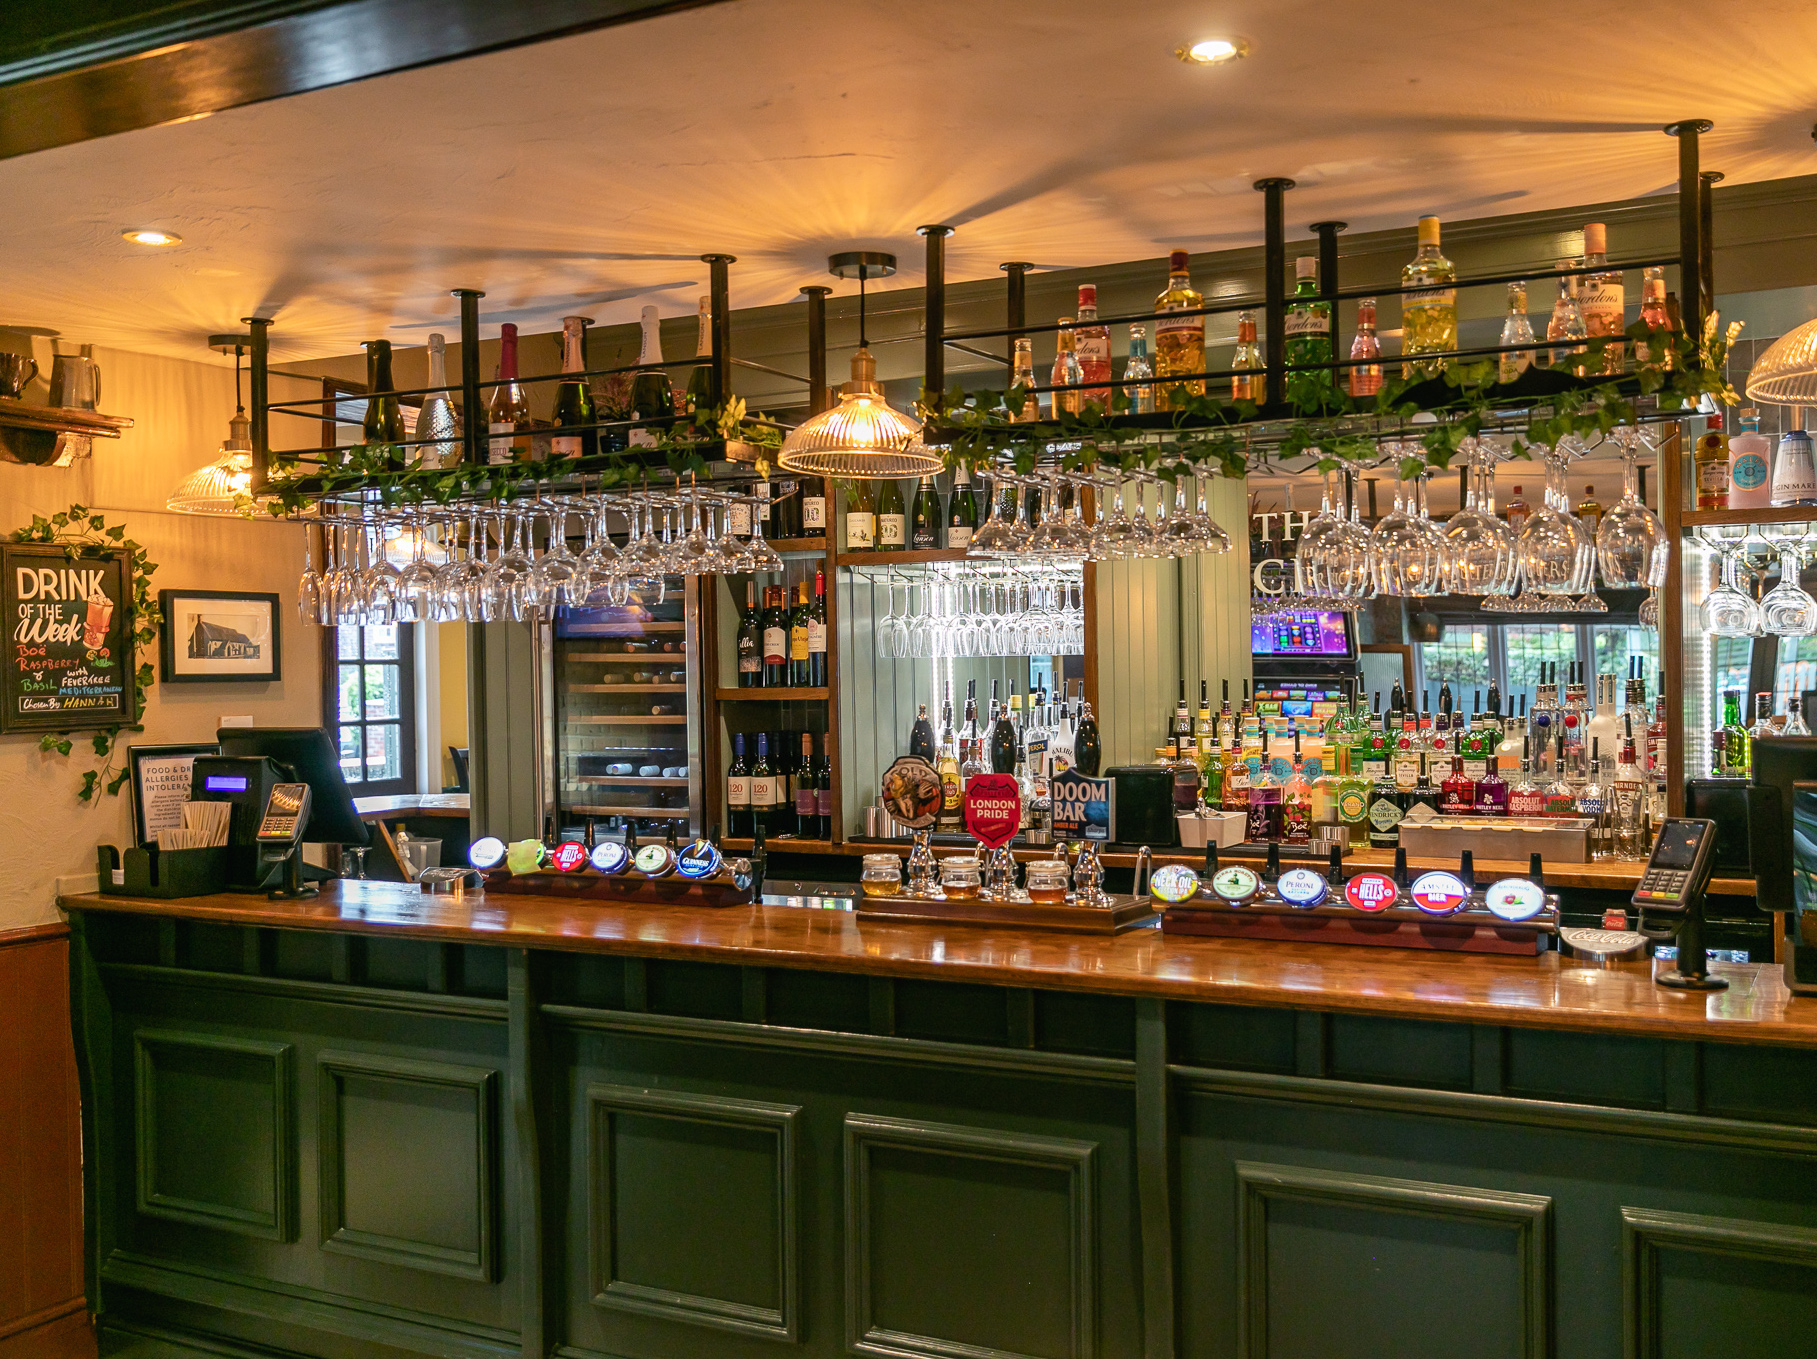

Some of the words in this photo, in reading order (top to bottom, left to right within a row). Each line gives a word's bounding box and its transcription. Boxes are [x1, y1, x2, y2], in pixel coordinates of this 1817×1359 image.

[1791, 482, 1817, 490] MARE
[1253, 510, 1336, 542] TH
[912, 532, 935, 544] Lanson
[16, 567, 106, 601] DRINK
[18, 603, 35, 619] OF
[37, 604, 63, 619] THE
[14, 613, 82, 647] Week
[16, 644, 47, 657] Boë
[15, 657, 80, 671] RASPBERRY
[66, 666, 89, 676] with
[63, 696, 114, 708] HANNAH
[145, 775, 189, 783] ALLERGIES
[729, 783, 744, 793] 120
[753, 784, 768, 793] 120
[1053, 781, 1106, 802] DOOM
[970, 799, 1016, 809] LONDON
[1511, 796, 1541, 804] ABSOLUT
[976, 809, 1009, 819] PRIDE
[1053, 801, 1087, 822] BAR
[1290, 821, 1308, 833] Boë
[560, 849, 579, 862] HELLS
[682, 857, 710, 867] GUINNESS
[1154, 875, 1178, 887] NECK
[1178, 876, 1192, 889] OIL
[1285, 880, 1315, 889] PERONI
[1358, 883, 1385, 900] HELLS
[1427, 892, 1447, 902] BIER
[1568, 929, 1636, 945] Coca-Cola
